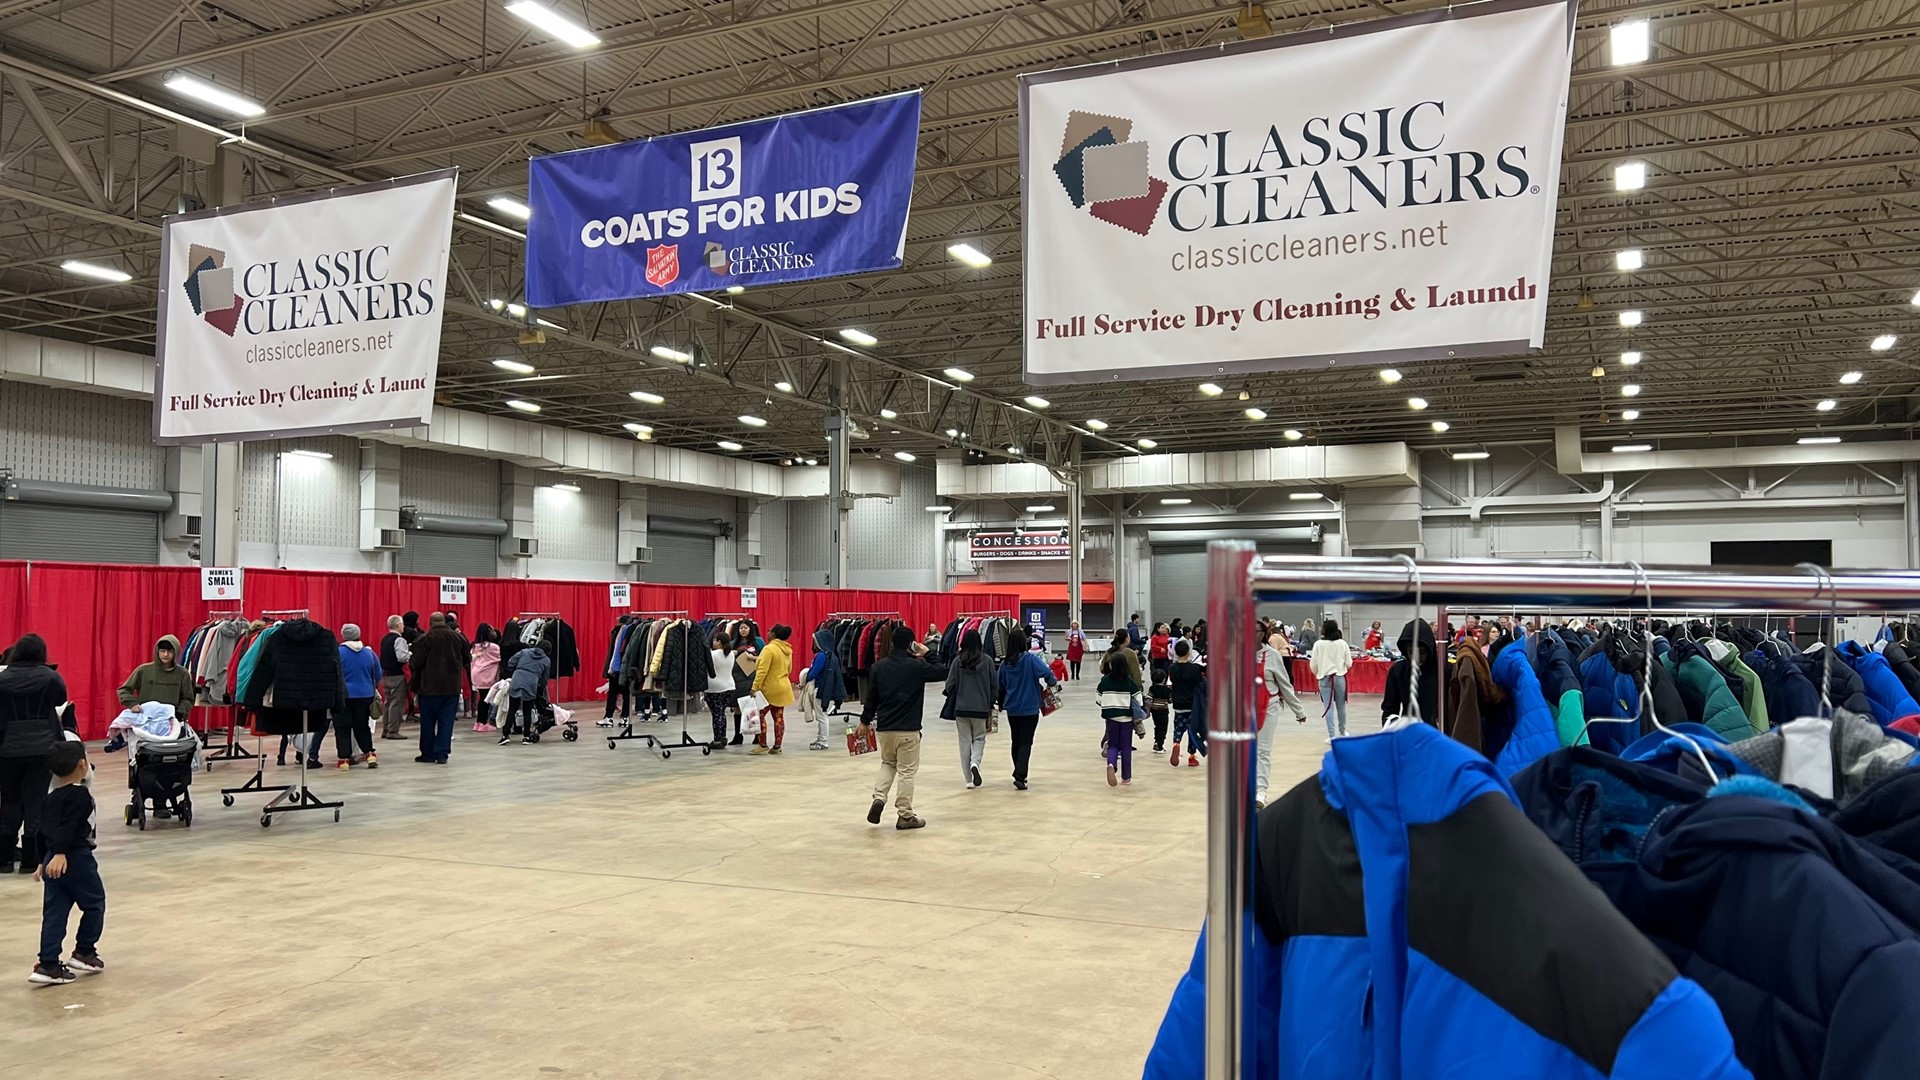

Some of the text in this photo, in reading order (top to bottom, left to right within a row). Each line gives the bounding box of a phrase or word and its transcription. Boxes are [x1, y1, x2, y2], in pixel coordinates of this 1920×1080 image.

[1168, 100, 1446, 182] CLASSIC
[698, 148, 735, 192] 13
[581, 182, 862, 248] COATS FOR KIDS
[648, 249, 675, 279] SALVATION
[651, 248, 664, 263] THE
[729, 241, 794, 262] CLASSIC
[1172, 220, 1448, 272] classiccleaners.net
[243, 245, 389, 298] CLASSIC
[657, 261, 675, 283] ARMY
[243, 278, 434, 335] CLEANERS
[1035, 316, 1086, 339] Full
[1094, 309, 1186, 336] Service
[1194, 303, 1243, 331] Dry
[1253, 291, 1381, 325] Cleaning
[1389, 287, 1416, 313] &
[246, 331, 393, 363] classiccleaners.net
[169, 393, 199, 411] Full
[203, 390, 255, 409] Service
[259, 386, 286, 408] Dry
[289, 381, 358, 403] Cleaning
[361, 378, 375, 395] &
[208, 577, 234, 585] SMALL
